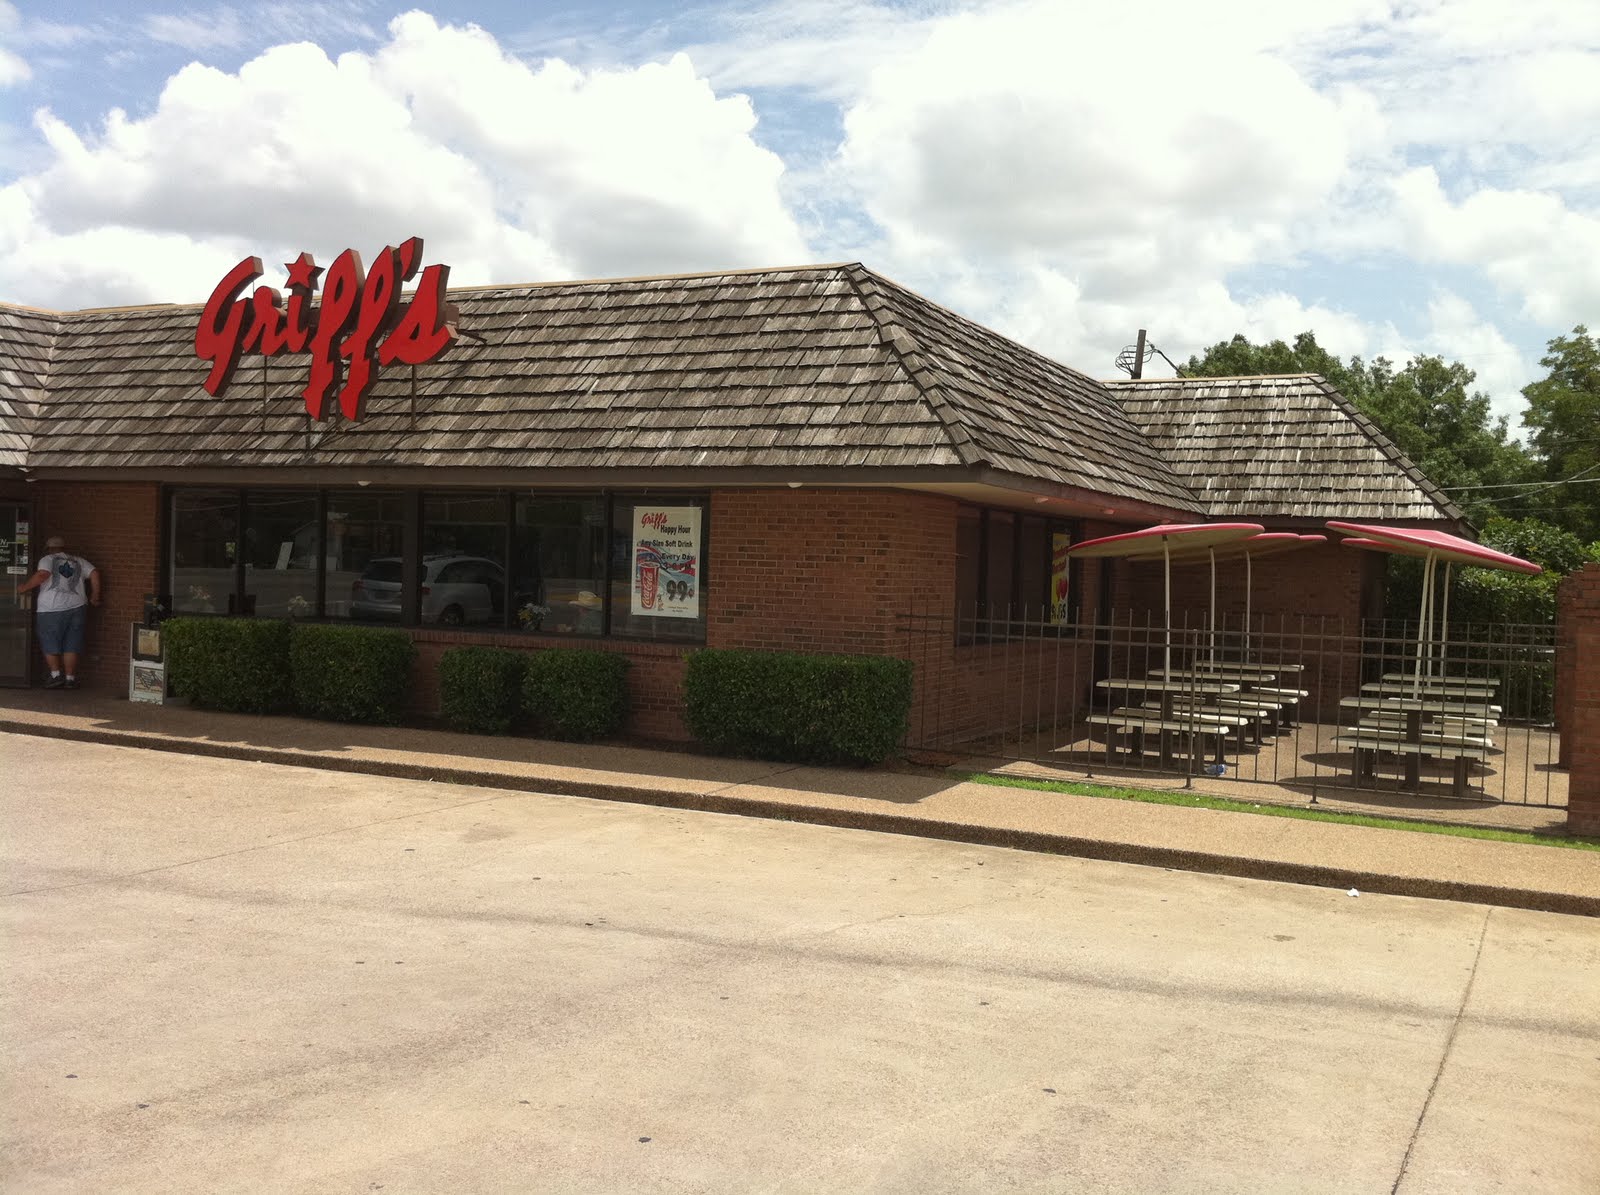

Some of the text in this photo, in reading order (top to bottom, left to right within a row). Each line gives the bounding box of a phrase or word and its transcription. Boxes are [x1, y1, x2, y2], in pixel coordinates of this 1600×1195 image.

[195, 236, 458, 422] Griff's
[641, 512, 668, 530] Griff's
[661, 525, 691, 536] Happy Hour
[662, 553, 681, 561] Every
